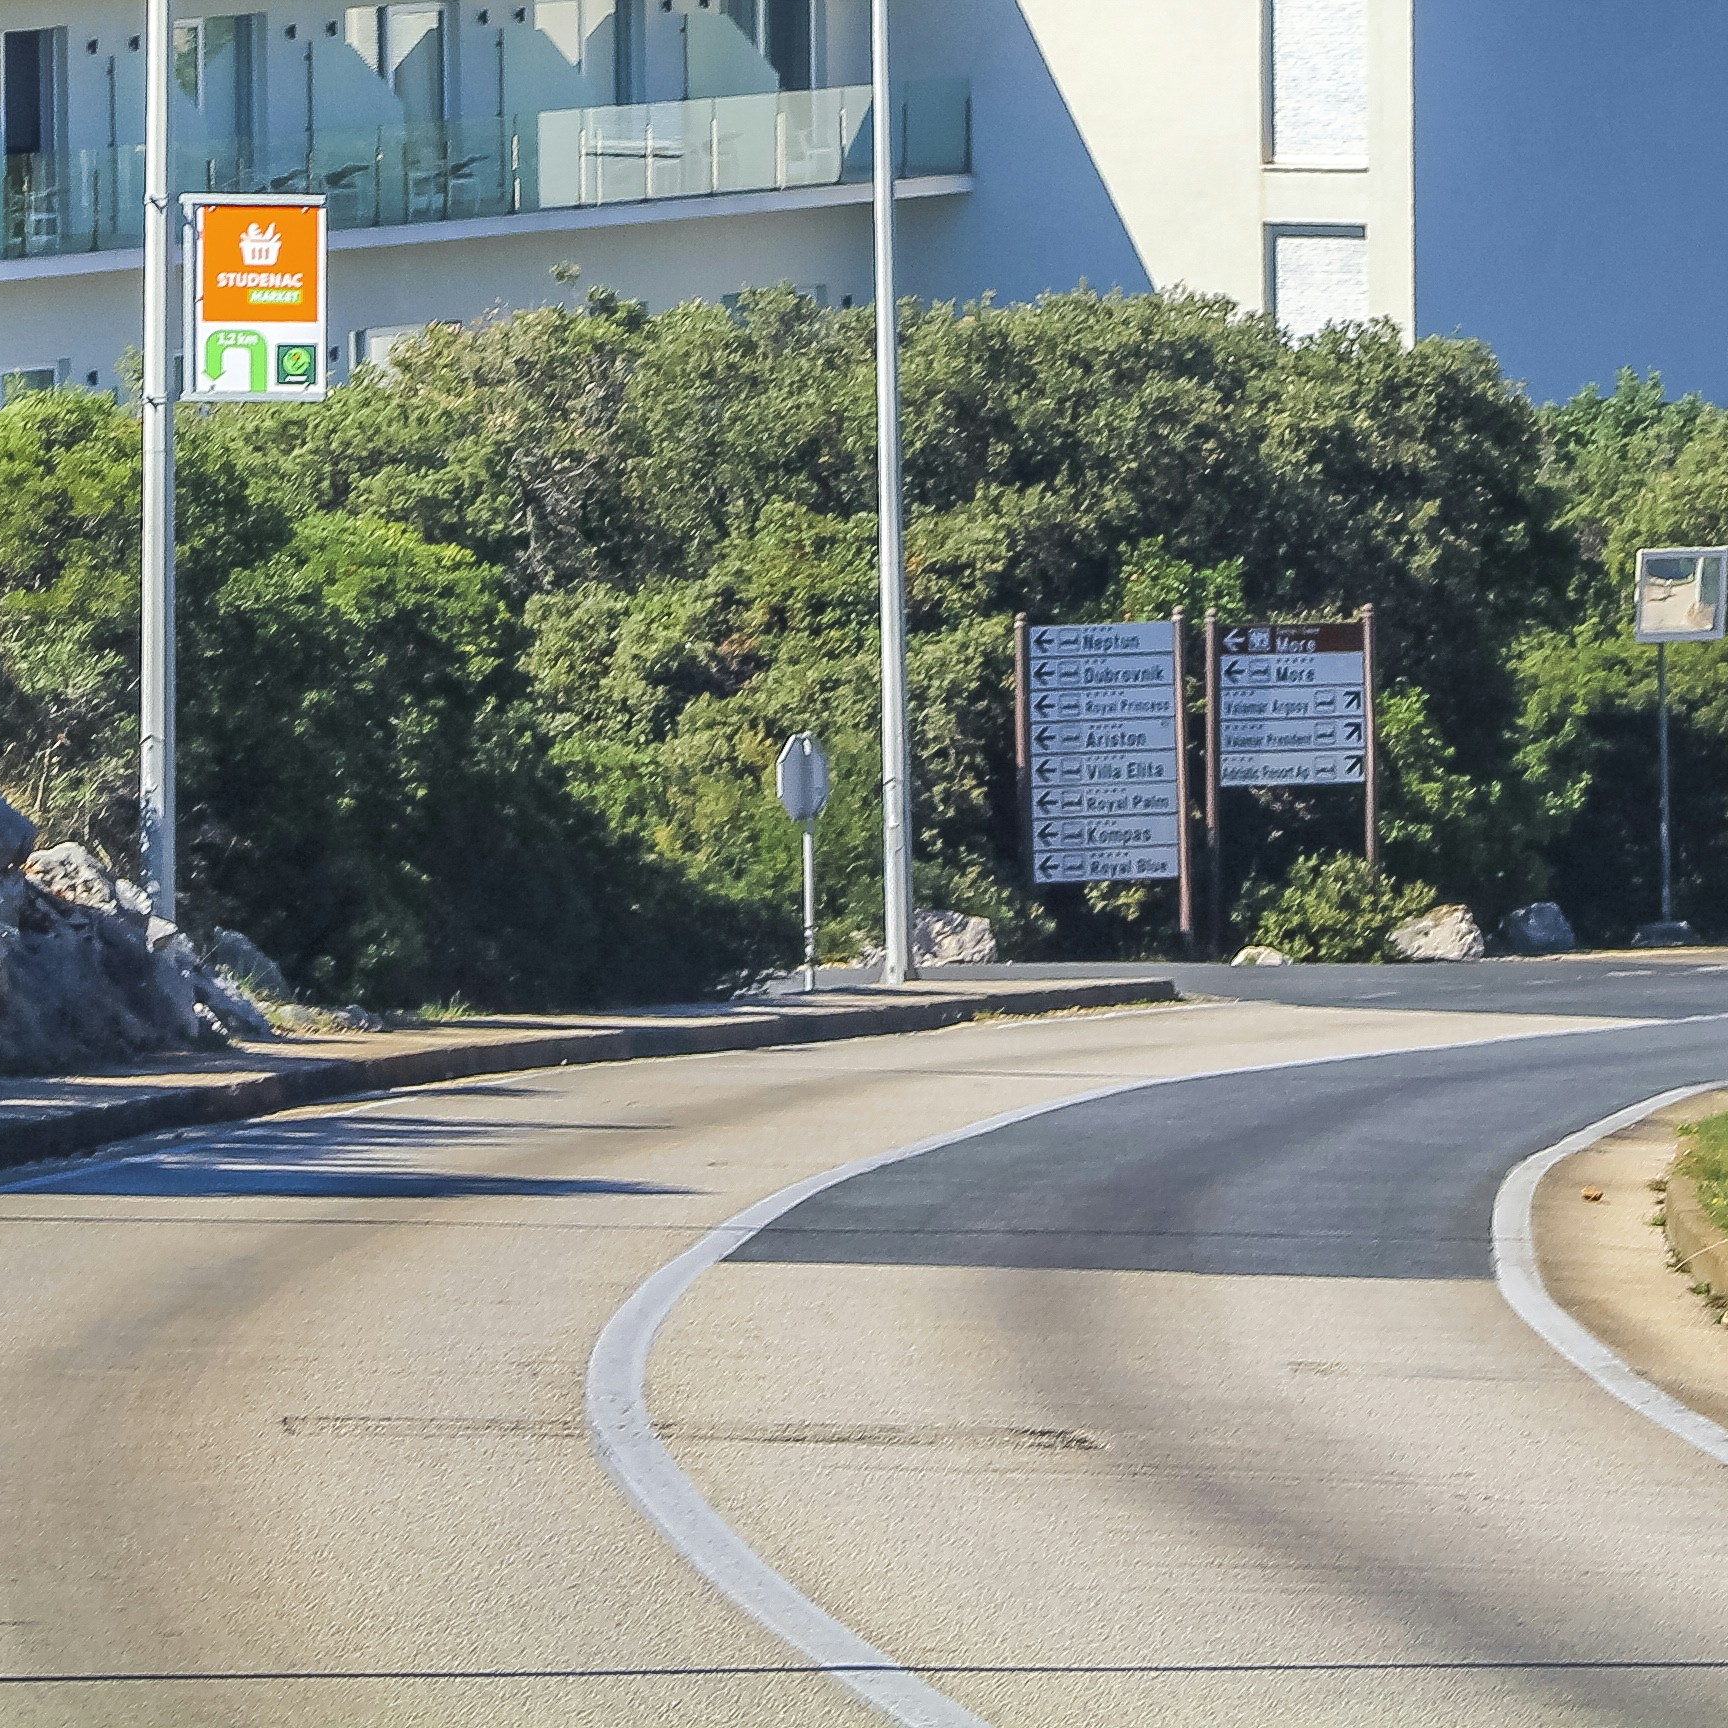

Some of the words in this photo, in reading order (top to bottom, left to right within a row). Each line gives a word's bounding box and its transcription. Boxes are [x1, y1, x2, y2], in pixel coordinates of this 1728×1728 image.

[237, 333, 258, 345] km
[1275, 637, 1317, 653] More
[1084, 665, 1164, 684] Dubrovnik
[1275, 666, 1315, 683] More
[1085, 700, 1118, 715] Royal
[1119, 698, 1170, 712] Princess
[1086, 731, 1147, 748] Ariston
[1086, 763, 1122, 780] Villa
[1086, 796, 1128, 813] Royal
[1086, 827, 1152, 846] Kompas
[1090, 860, 1133, 877] Royal
